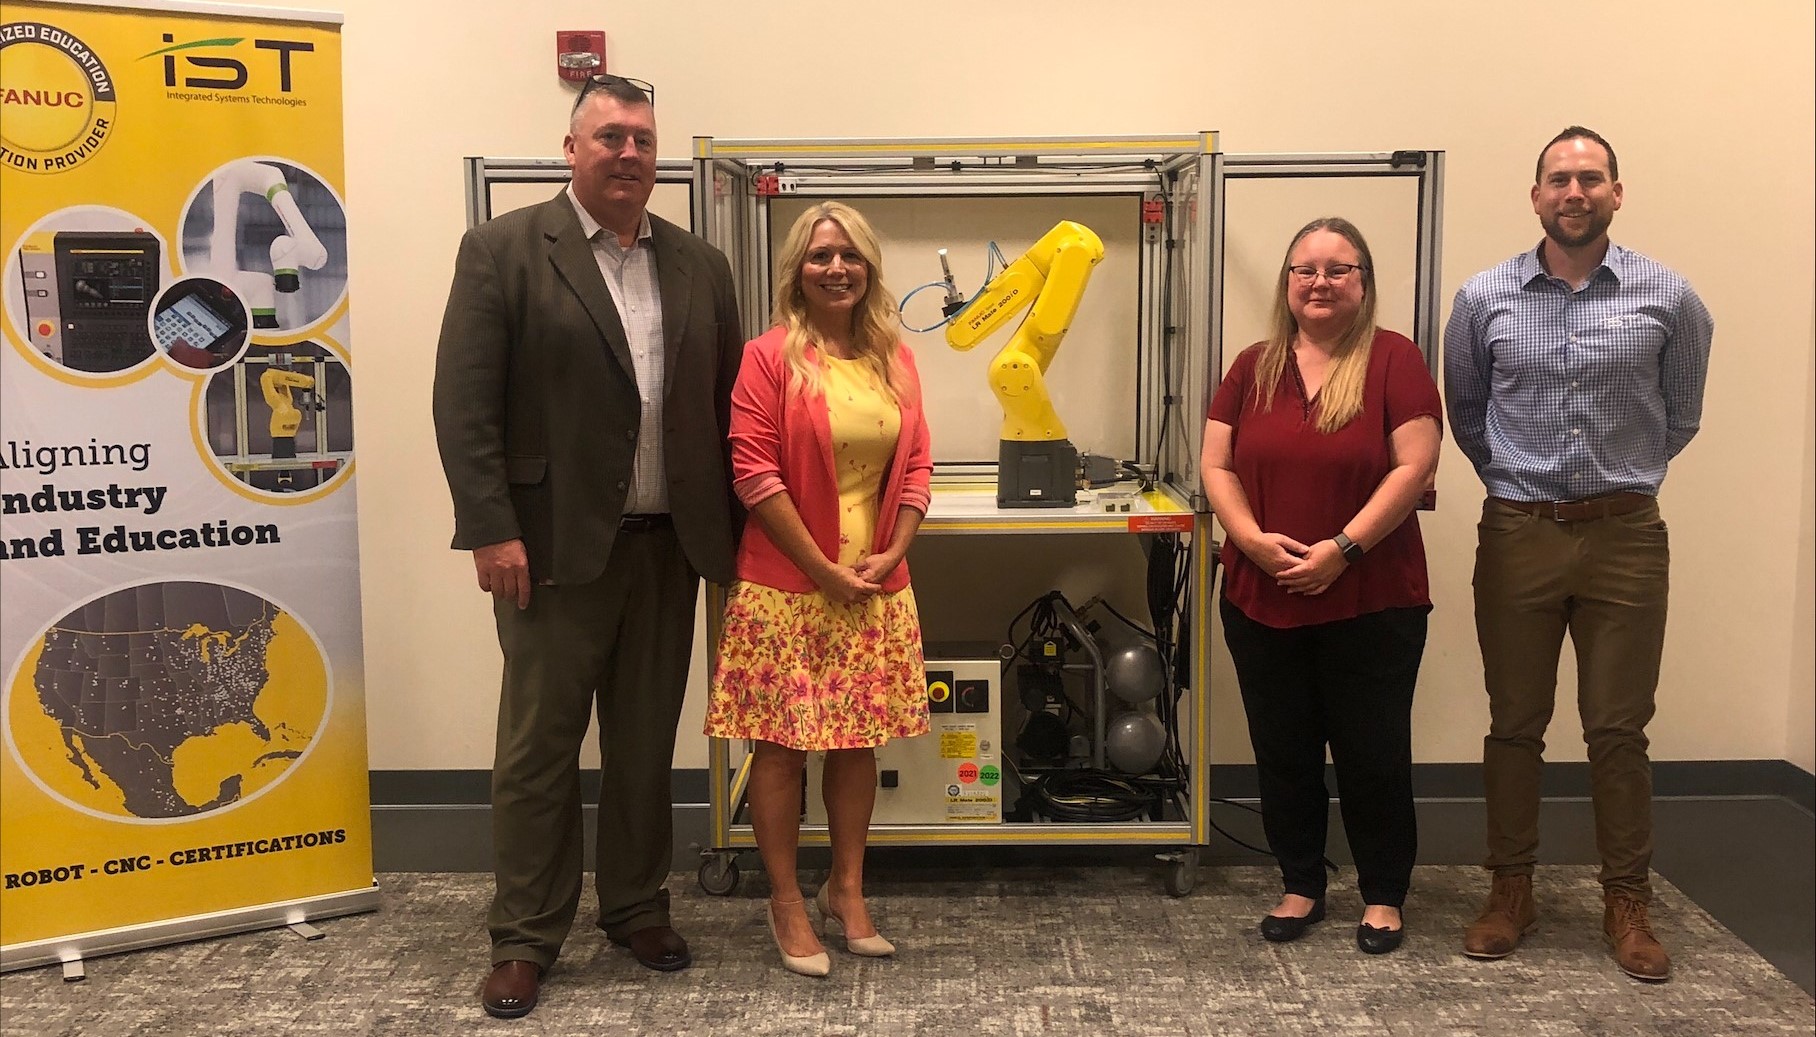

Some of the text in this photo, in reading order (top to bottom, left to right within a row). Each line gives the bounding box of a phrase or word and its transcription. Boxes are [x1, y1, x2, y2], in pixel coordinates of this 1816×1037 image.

[40, 27, 110, 93] EDUCATION
[569, 70, 592, 78] FIRE
[166, 91, 307, 107] Integrated Systems Technologies
[44, 118, 109, 170] PROVIDER
[971, 320, 981, 330] LR
[981, 308, 997, 321] Mate
[0, 484, 167, 515] ndustry
[76, 519, 281, 555] Education
[959, 769, 977, 778] 2021
[980, 771, 1000, 780] 2022
[5, 864, 85, 889] ROBOT
[103, 855, 151, 876] CNC
[169, 828, 346, 867] CERTIFICATIONS
